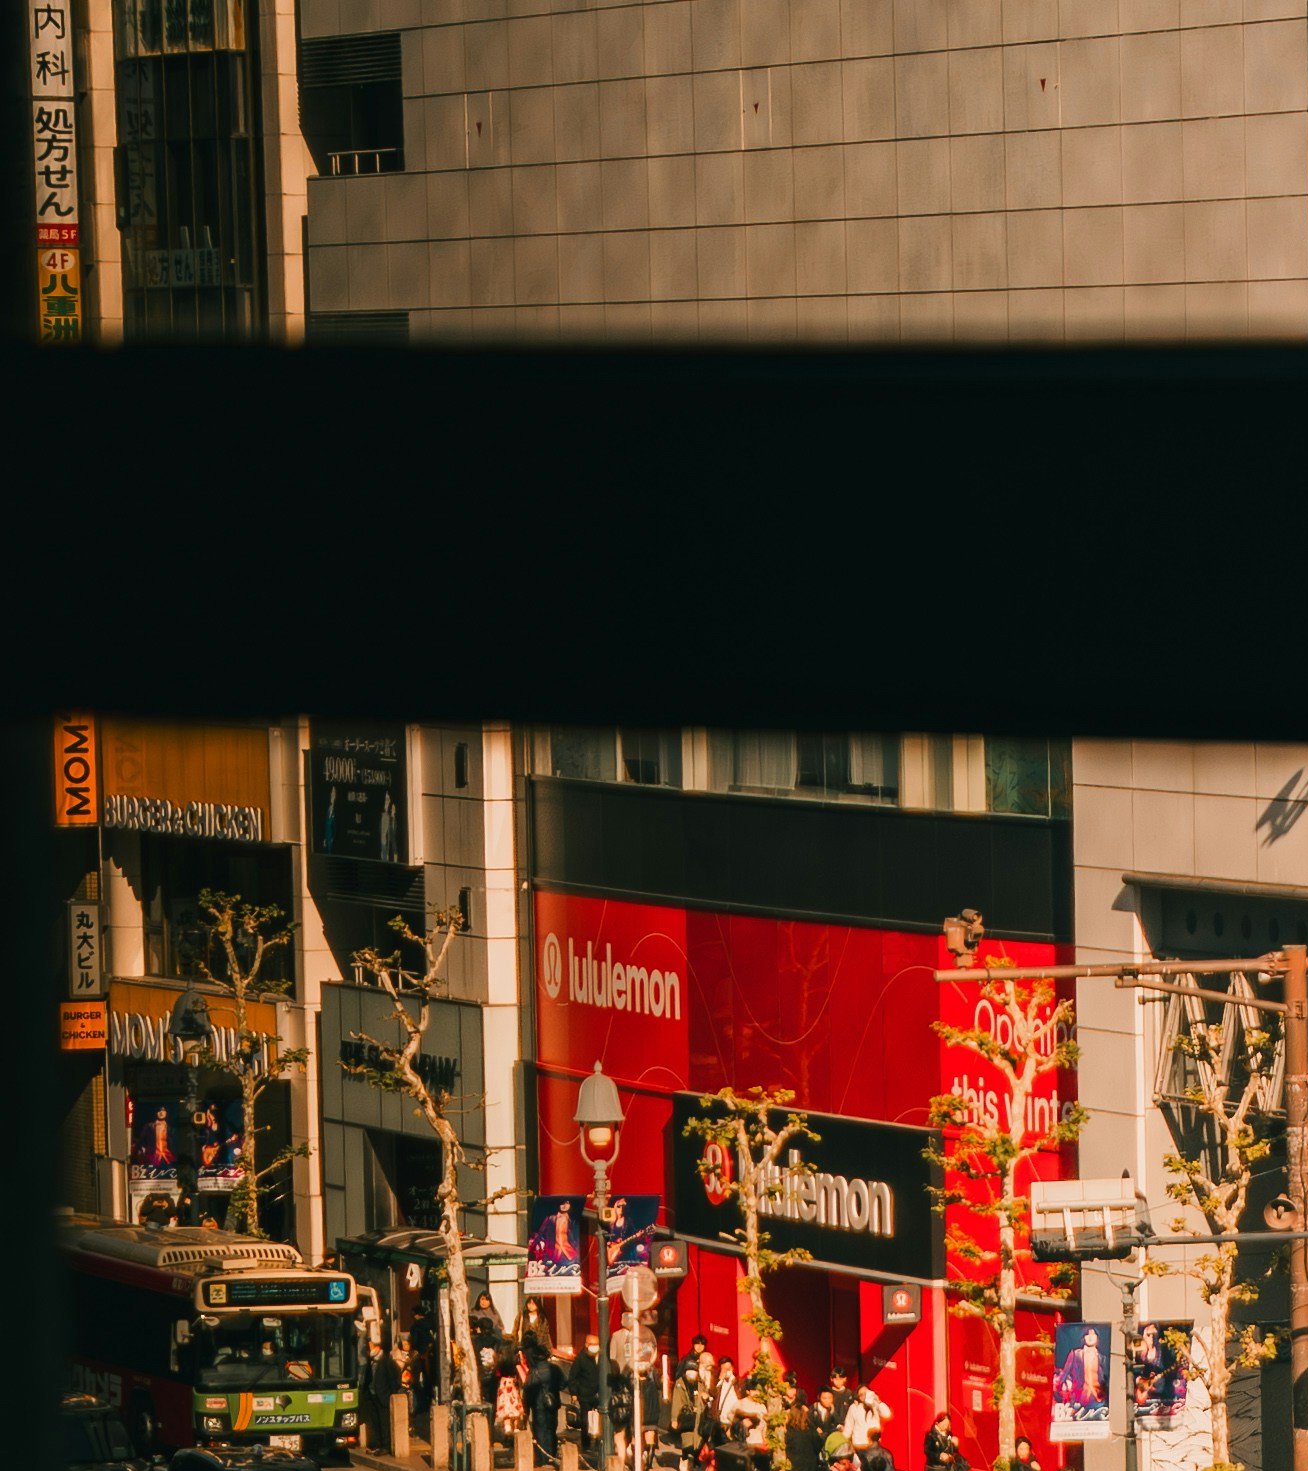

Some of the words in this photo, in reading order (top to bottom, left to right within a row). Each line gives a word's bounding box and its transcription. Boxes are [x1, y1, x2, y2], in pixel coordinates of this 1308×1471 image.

[35, 106, 75, 217] 処方せん
[46, 252, 70, 270] 4F
[104, 796, 173, 833] BURGER
[186, 802, 263, 842] CHICKEN
[76, 911, 95, 989] 丸大ビル
[569, 937, 681, 1021] lululemon
[62, 1030, 105, 1041] CHICKEN
[63, 1010, 102, 1022] BURGER
